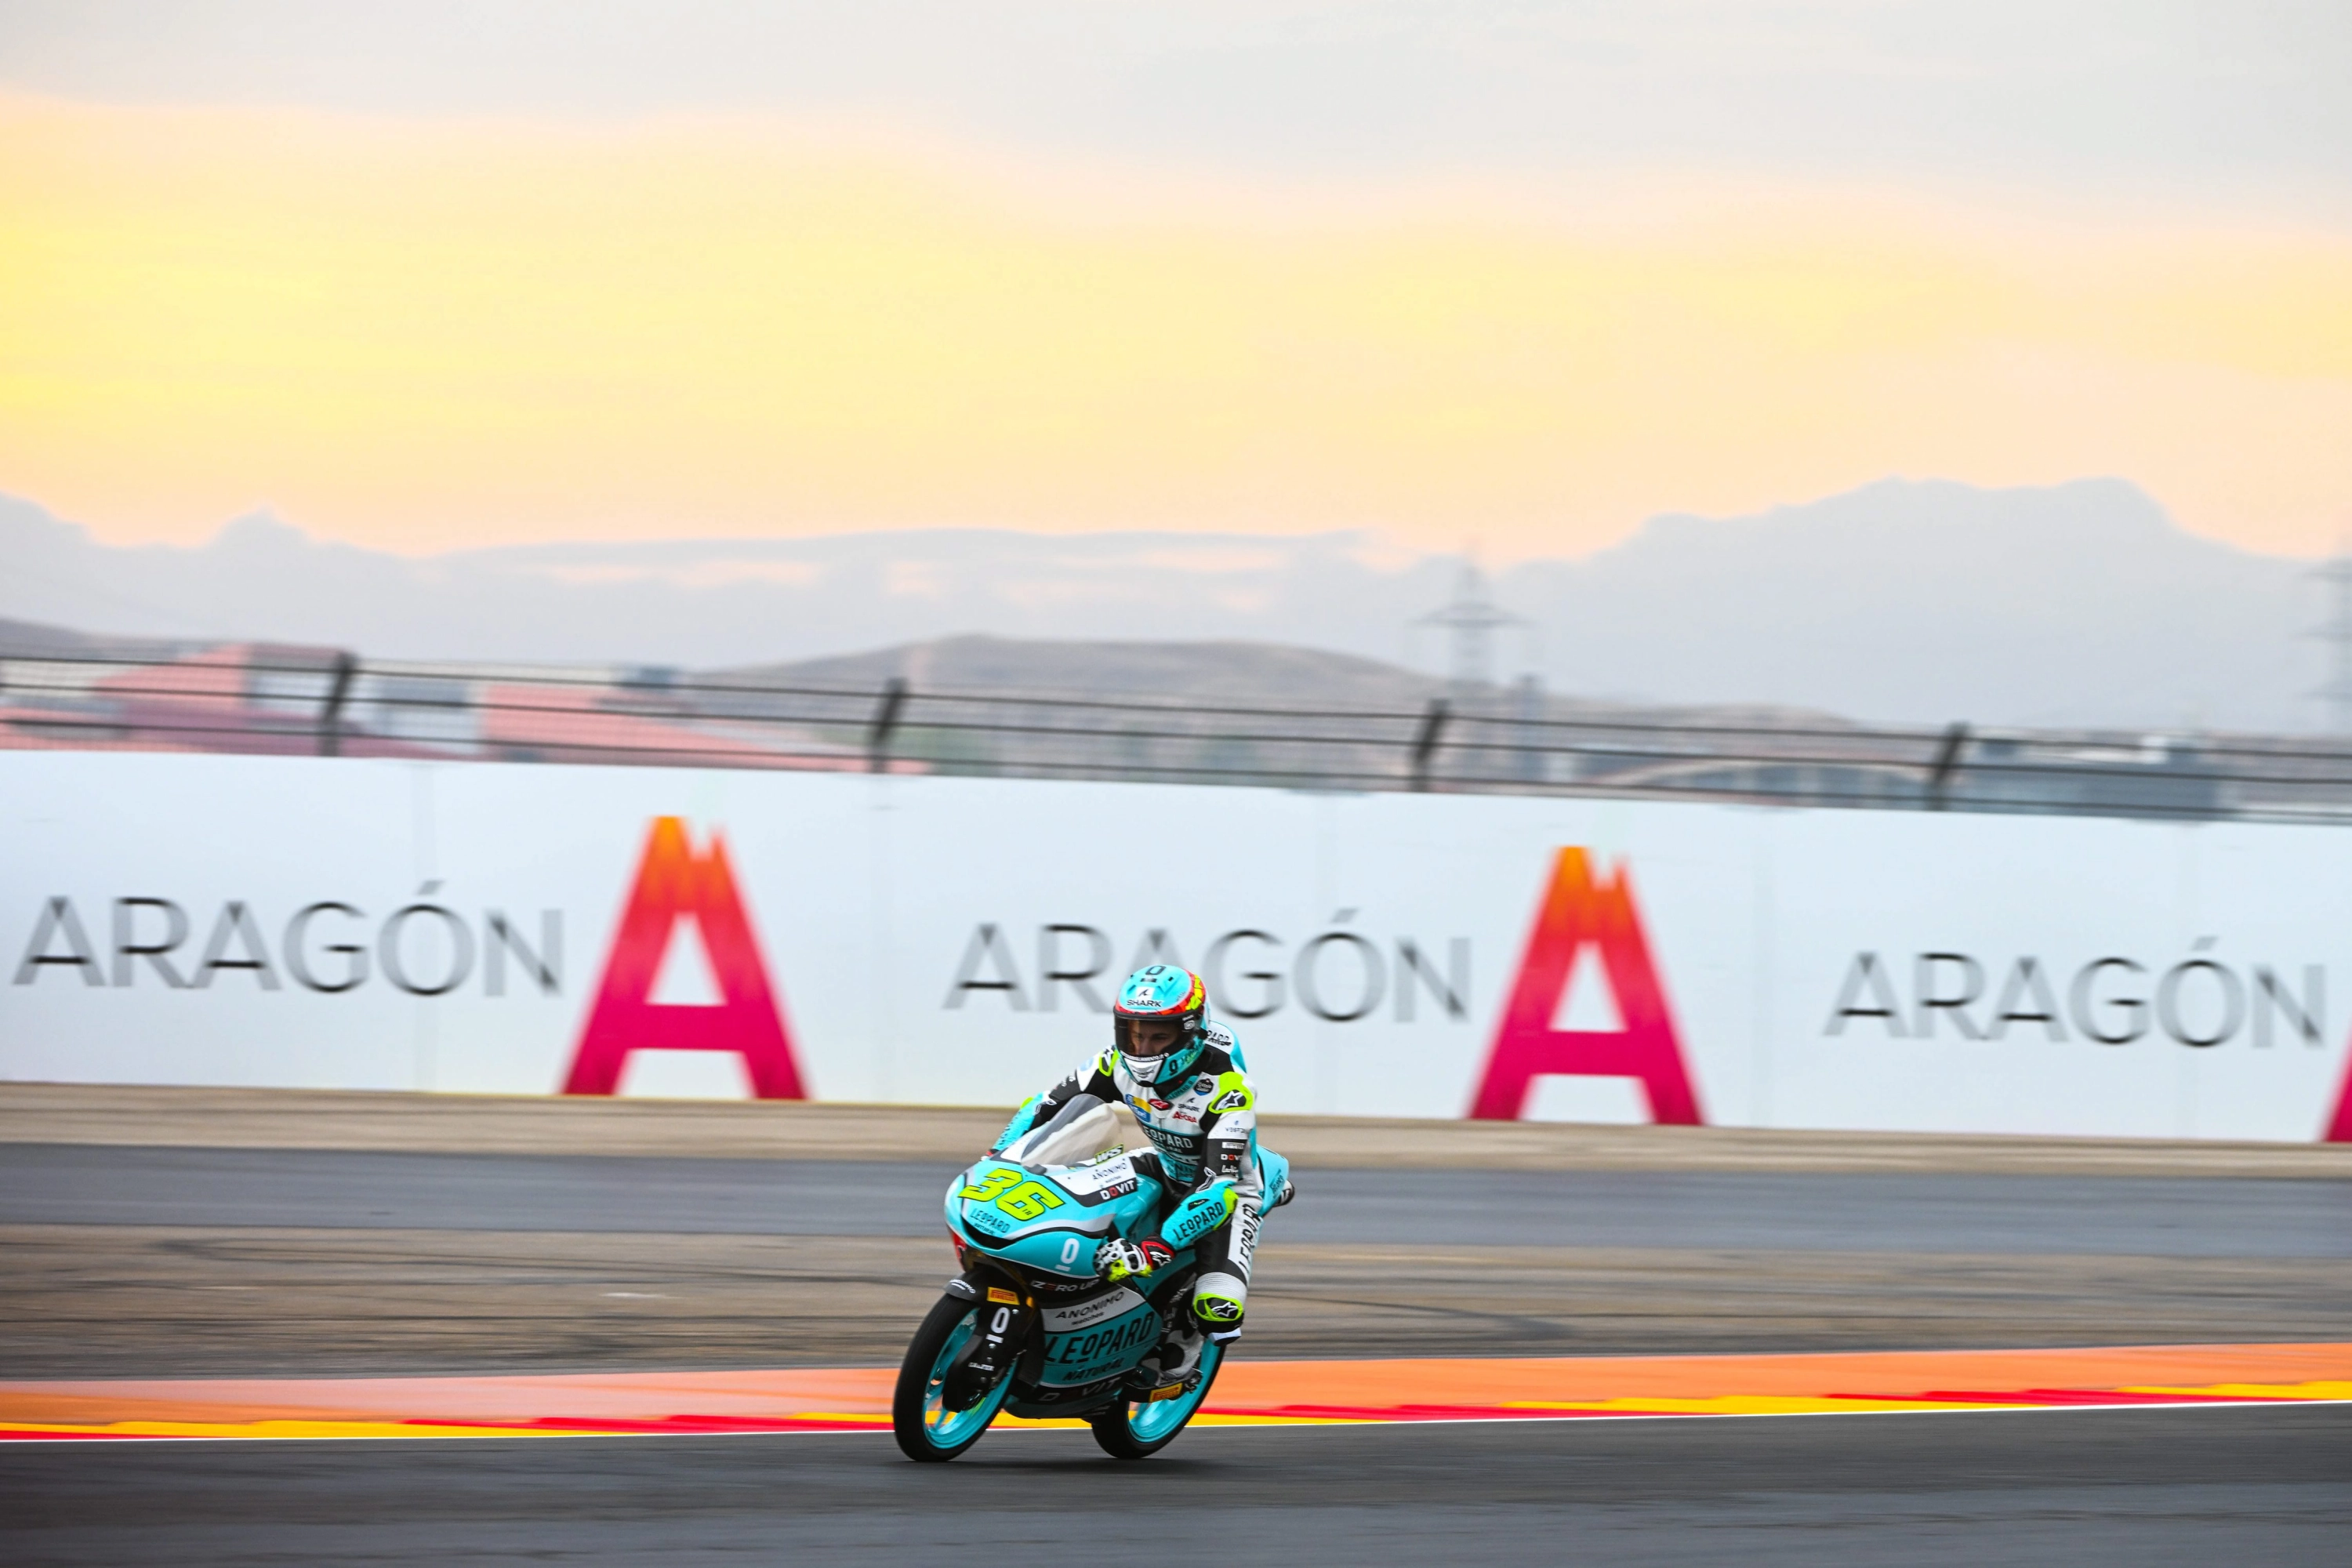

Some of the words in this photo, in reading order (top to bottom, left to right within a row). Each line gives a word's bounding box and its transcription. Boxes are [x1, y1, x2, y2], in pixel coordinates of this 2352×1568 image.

[12, 879, 563, 997] ARAGÓN
[1126, 999, 1162, 1007] SHARK
[1821, 935, 2327, 1048] ARAGÓN
[1143, 1126, 1194, 1149] EOPARD
[957, 1167, 1066, 1221] 36
[1099, 1179, 1134, 1200] DOVIT
[970, 1208, 1011, 1233] LEOPARD
[1173, 1202, 1225, 1241] LEOPARD
[1055, 1291, 1125, 1319] ANONIMO
[1045, 1311, 1156, 1365] LEOPARD
[1062, 1357, 1125, 1381] NATURAL
[1039, 1376, 1123, 1402] DVIT
